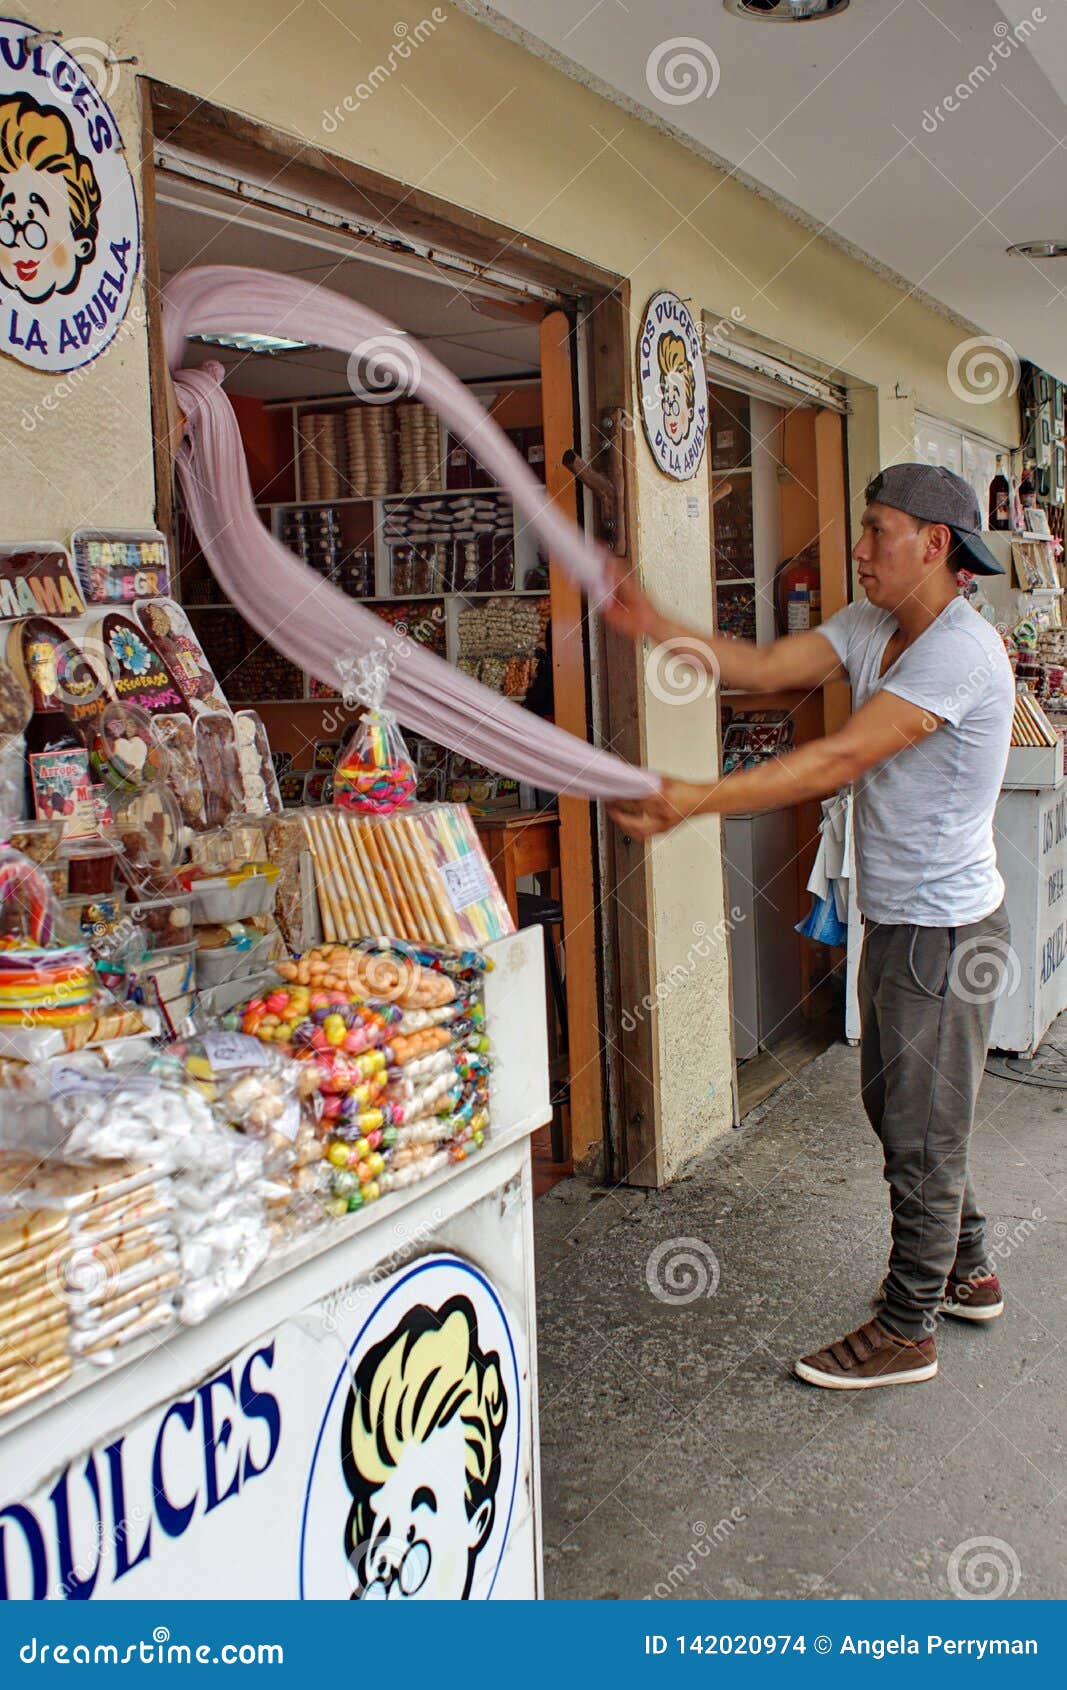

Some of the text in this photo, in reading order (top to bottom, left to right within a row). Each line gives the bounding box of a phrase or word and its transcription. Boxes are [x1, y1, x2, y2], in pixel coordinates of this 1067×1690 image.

[8, 237, 131, 354] LA ABUELA
[641, 301, 699, 380] LOS DULCES
[655, 429, 667, 460] DE
[669, 450, 681, 473] LA
[684, 404, 705, 472] ABUELA
[0, 1337, 281, 1600] DULCES
